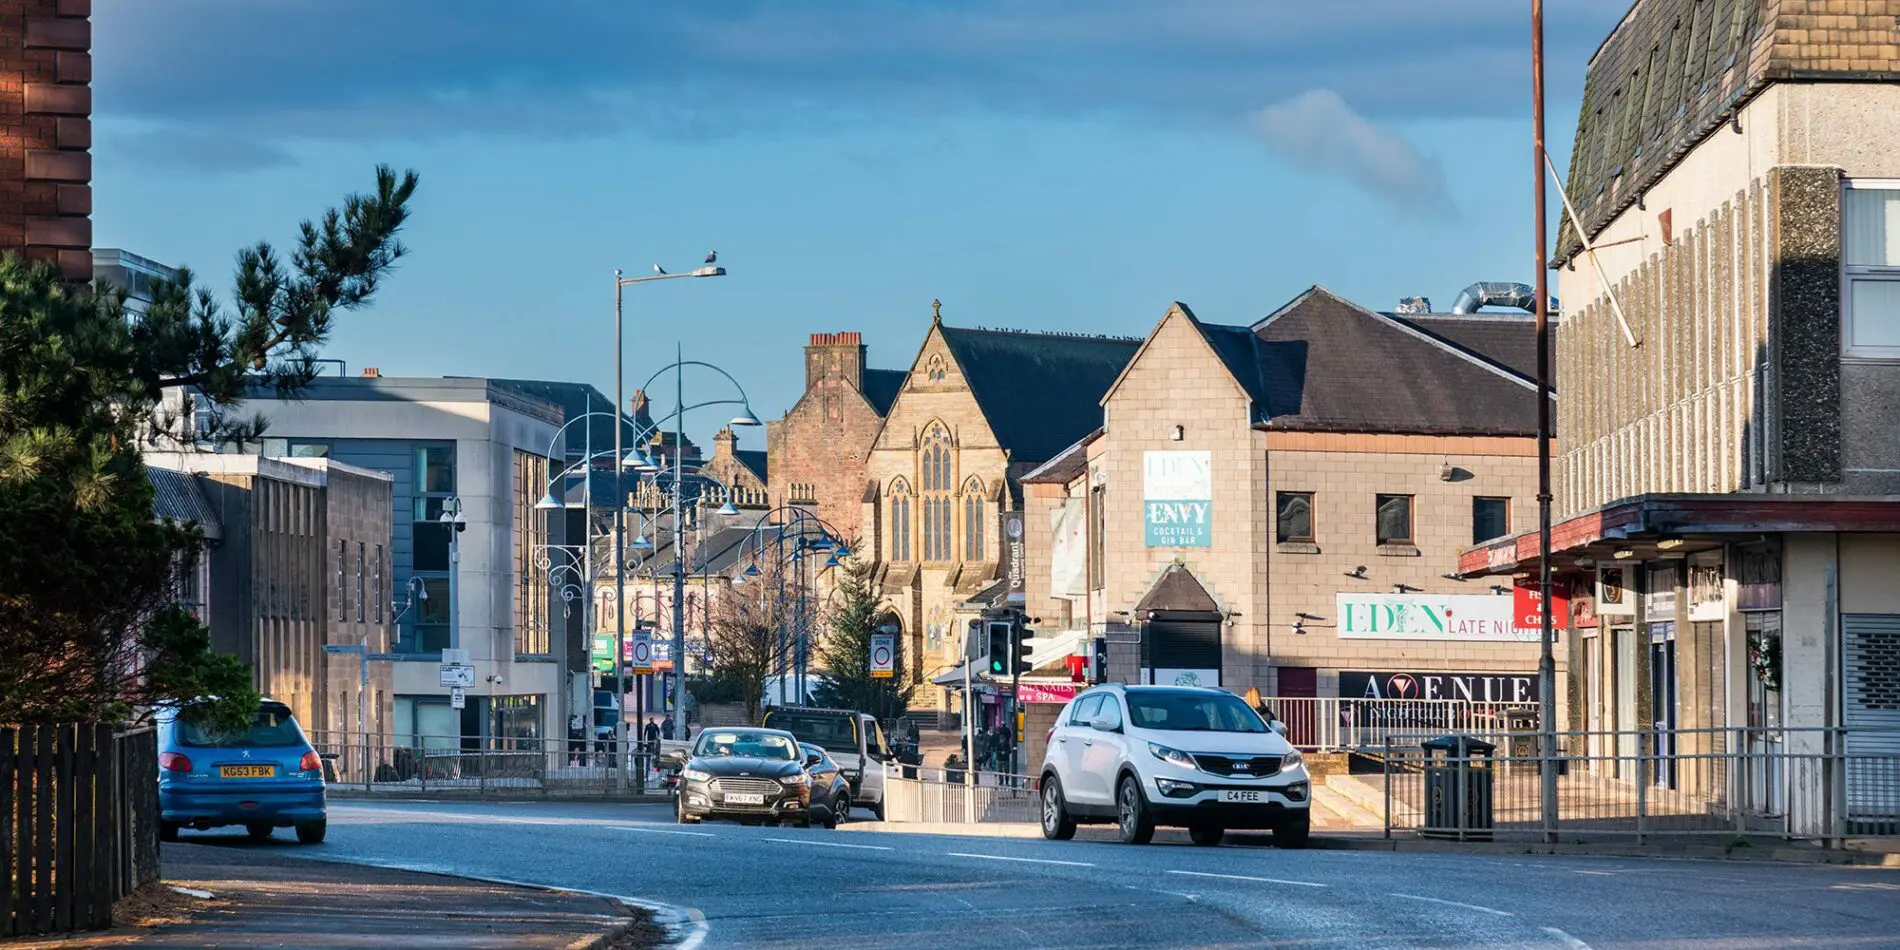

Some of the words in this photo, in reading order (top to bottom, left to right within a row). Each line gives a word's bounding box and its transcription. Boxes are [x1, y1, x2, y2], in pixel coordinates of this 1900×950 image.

[1149, 502, 1209, 524] ENVY
[1153, 527, 1194, 536] COCKTAIL
[1161, 536, 1176, 545] GIN
[1180, 536, 1196, 545] BAR
[1010, 541, 1022, 588] Quadrant
[1345, 603, 1446, 632] EDEN
[1525, 615, 1557, 625] CHS
[1449, 619, 1486, 634] LATE
[1043, 684, 1072, 692] NAILS
[1036, 692, 1055, 701] SPA
[223, 766, 249, 777] KG53
[251, 766, 271, 777] FBK
[1227, 791, 1239, 800] C4
[1241, 791, 1259, 800] FEE
